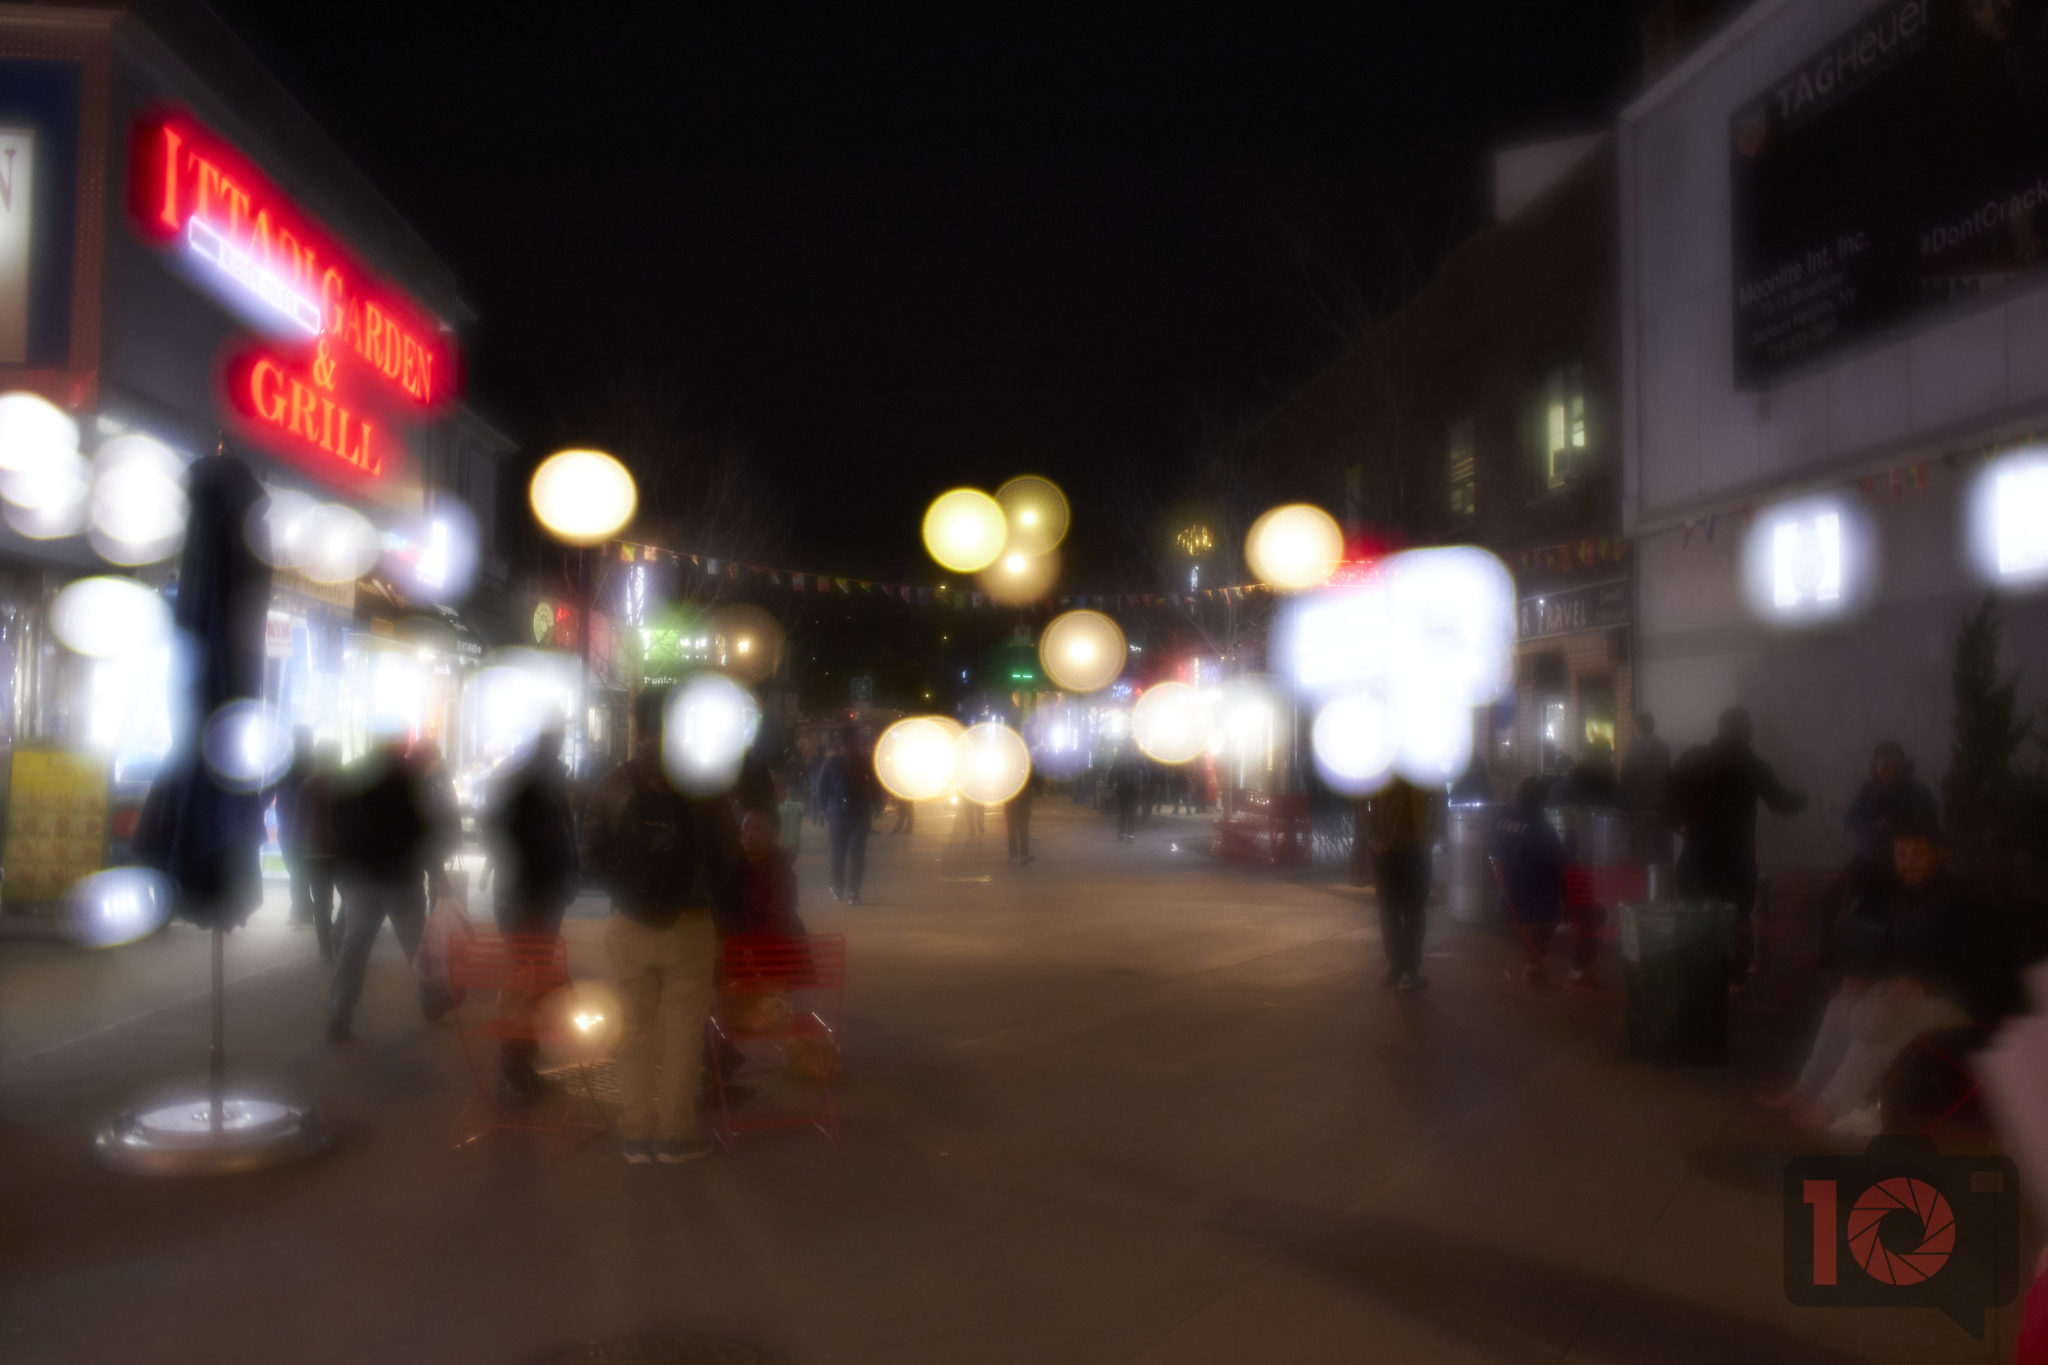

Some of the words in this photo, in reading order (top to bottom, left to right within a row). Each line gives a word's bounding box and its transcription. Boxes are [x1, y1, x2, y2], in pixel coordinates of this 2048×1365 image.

[1838, 231, 1870, 260] Inc.
[322, 267, 434, 405] GARDEN
[313, 339, 337, 391] &
[250, 360, 382, 477] GRILL
[1537, 599, 1588, 635] TRAVEL
